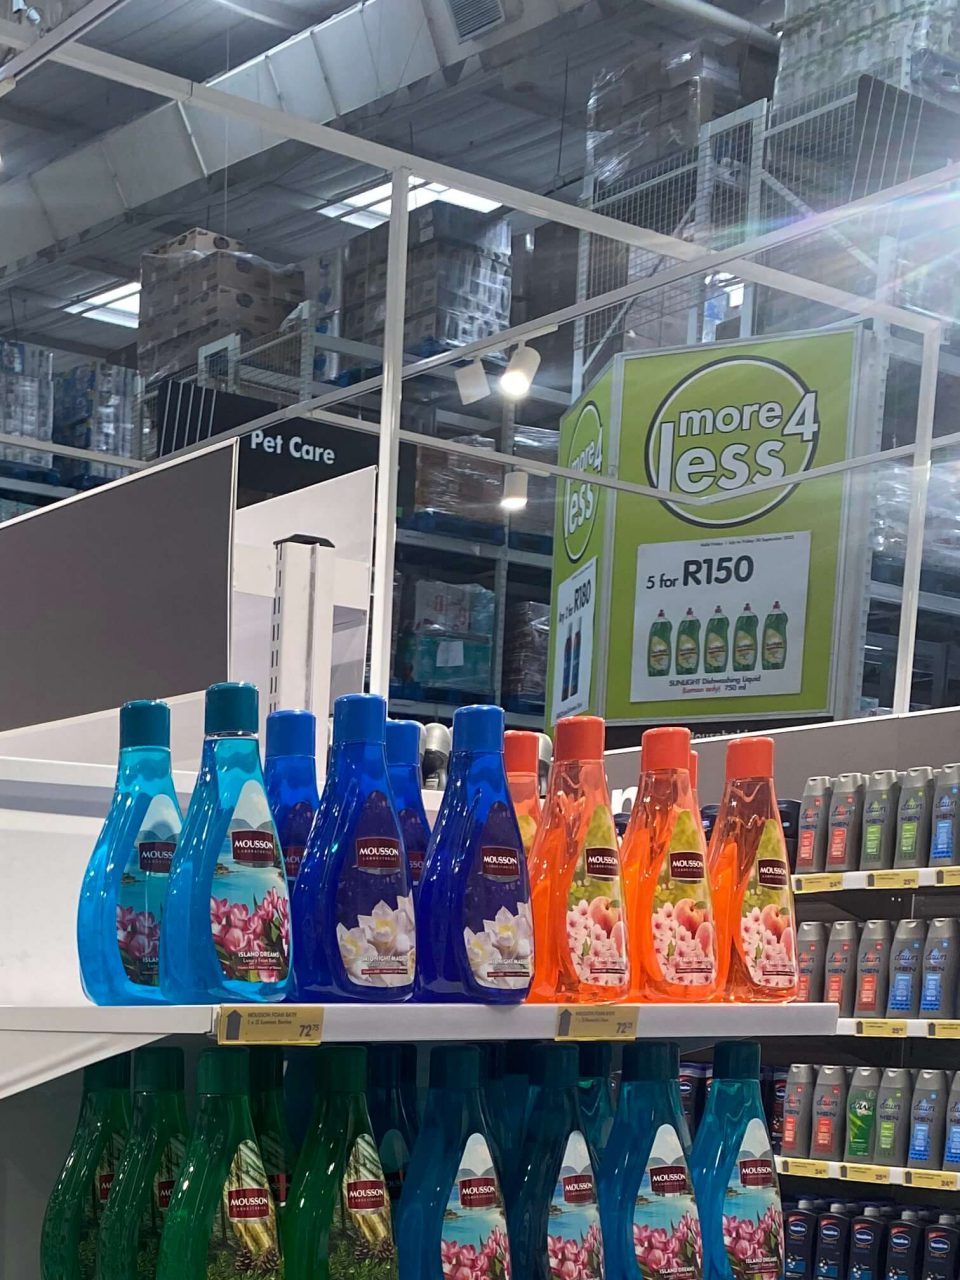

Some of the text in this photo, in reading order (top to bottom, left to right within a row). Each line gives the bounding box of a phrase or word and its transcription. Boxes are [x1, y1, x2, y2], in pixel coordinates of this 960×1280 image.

[678, 399, 782, 438] more
[250, 429, 335, 464] Pet Care
[658, 421, 787, 494] less
[646, 555, 754, 589] 5 for R150
[742, 675, 761, 683] Liquid
[234, 839, 274, 849] MOUSSON
[141, 850, 174, 859] MOUSS
[359, 847, 399, 856] MOUSSON
[483, 855, 517, 864] MOUSSON
[588, 856, 618, 864] MOUSSON
[672, 859, 703, 868] MOUSSON
[760, 866, 786, 875] MOUSSON
[742, 1166, 772, 1174] MOUSSON
[652, 1173, 687, 1182] MOUSSON
[462, 1186, 496, 1195] MOUSSON
[565, 1183, 593, 1192] MOUSSON
[349, 1188, 384, 1198] MOUSSON
[230, 1197, 268, 1207] MOUSSON
